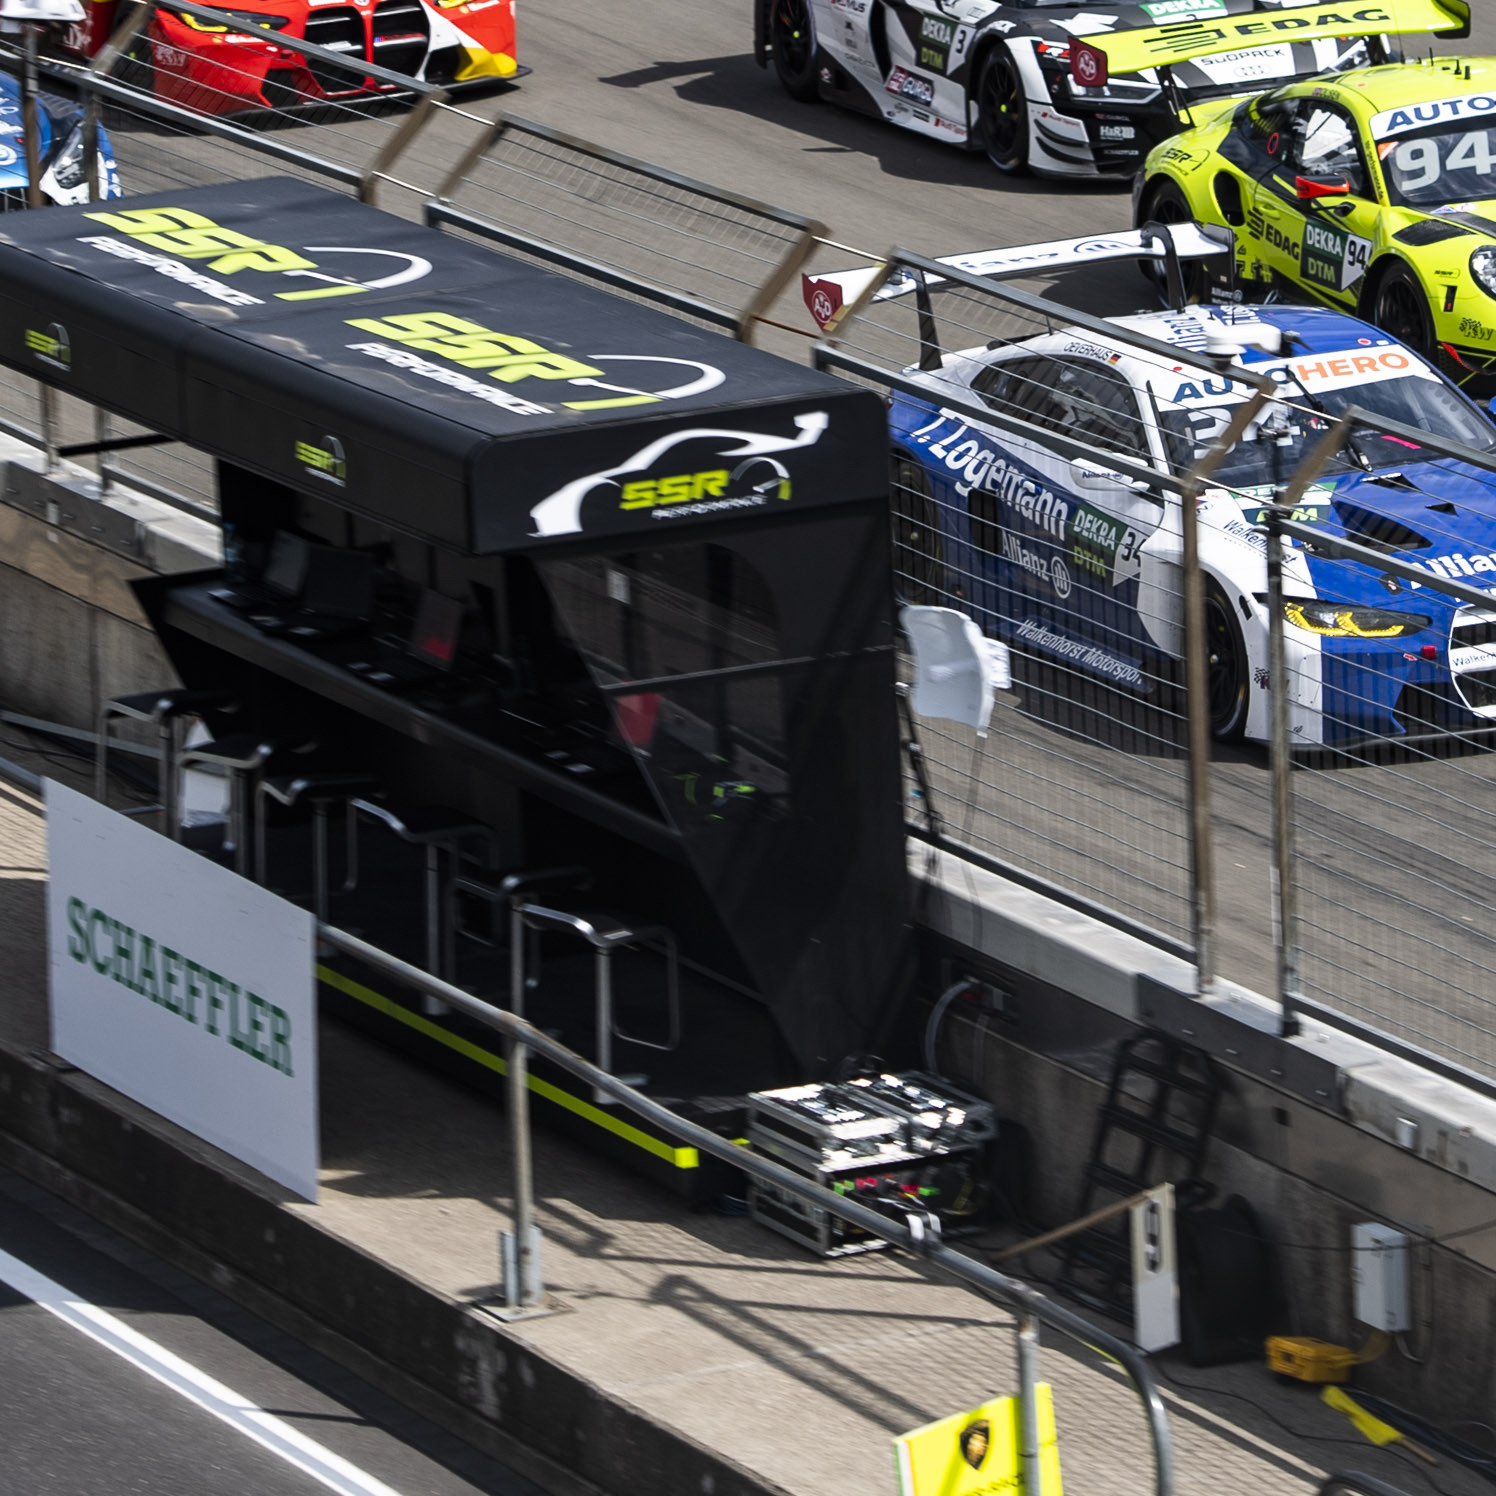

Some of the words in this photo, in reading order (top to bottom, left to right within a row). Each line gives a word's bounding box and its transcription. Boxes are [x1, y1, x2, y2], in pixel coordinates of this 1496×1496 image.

[921, 17, 952, 45] DEKRA
[955, 29, 968, 54] 3
[1235, 8, 1392, 37] EDAG
[920, 46, 944, 70] DTM
[1199, 47, 1286, 67] SÜDPACK
[83, 205, 320, 276] SSR
[1265, 224, 1301, 262] EDAG
[1305, 223, 1343, 258] DEKRA
[1347, 239, 1368, 272] 94
[76, 236, 266, 307] PERFORMANCE
[1307, 256, 1336, 284] DTM
[342, 310, 605, 384] SSR
[1063, 341, 1112, 362] OEVERHAUS
[345, 341, 555, 416] PERFORMANCE
[620, 469, 732, 512] SSR
[1073, 508, 1117, 551] DEKRA
[1256, 506, 1320, 524] DM
[1074, 545, 1106, 577] DTM
[1016, 618, 1085, 661] Walkenhorst
[65, 895, 295, 1078] SCHAEFFLER
